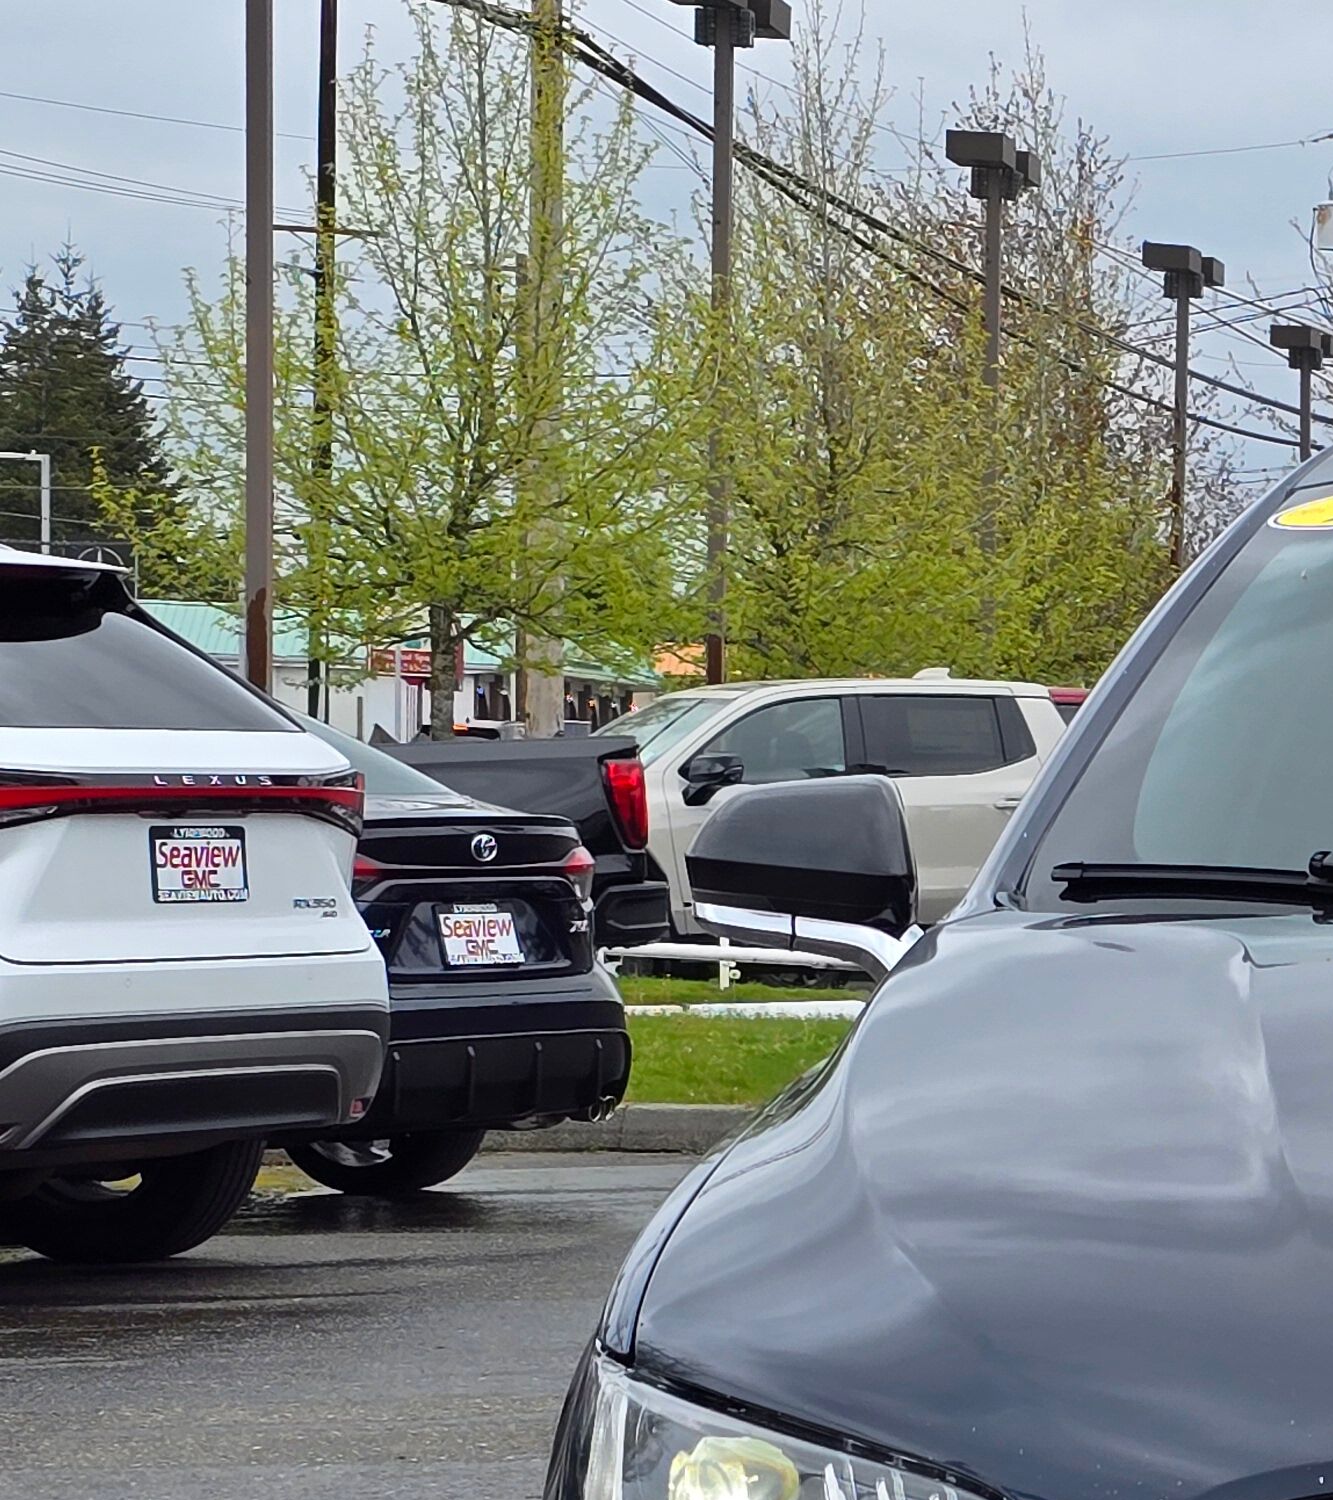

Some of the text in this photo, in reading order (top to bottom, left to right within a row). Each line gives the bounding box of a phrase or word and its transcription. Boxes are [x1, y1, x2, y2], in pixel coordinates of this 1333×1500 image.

[153, 775, 273, 785] LEXUS
[156, 841, 240, 869] Seaview
[181, 870, 221, 889] GMC
[441, 916, 513, 938] Seaview
